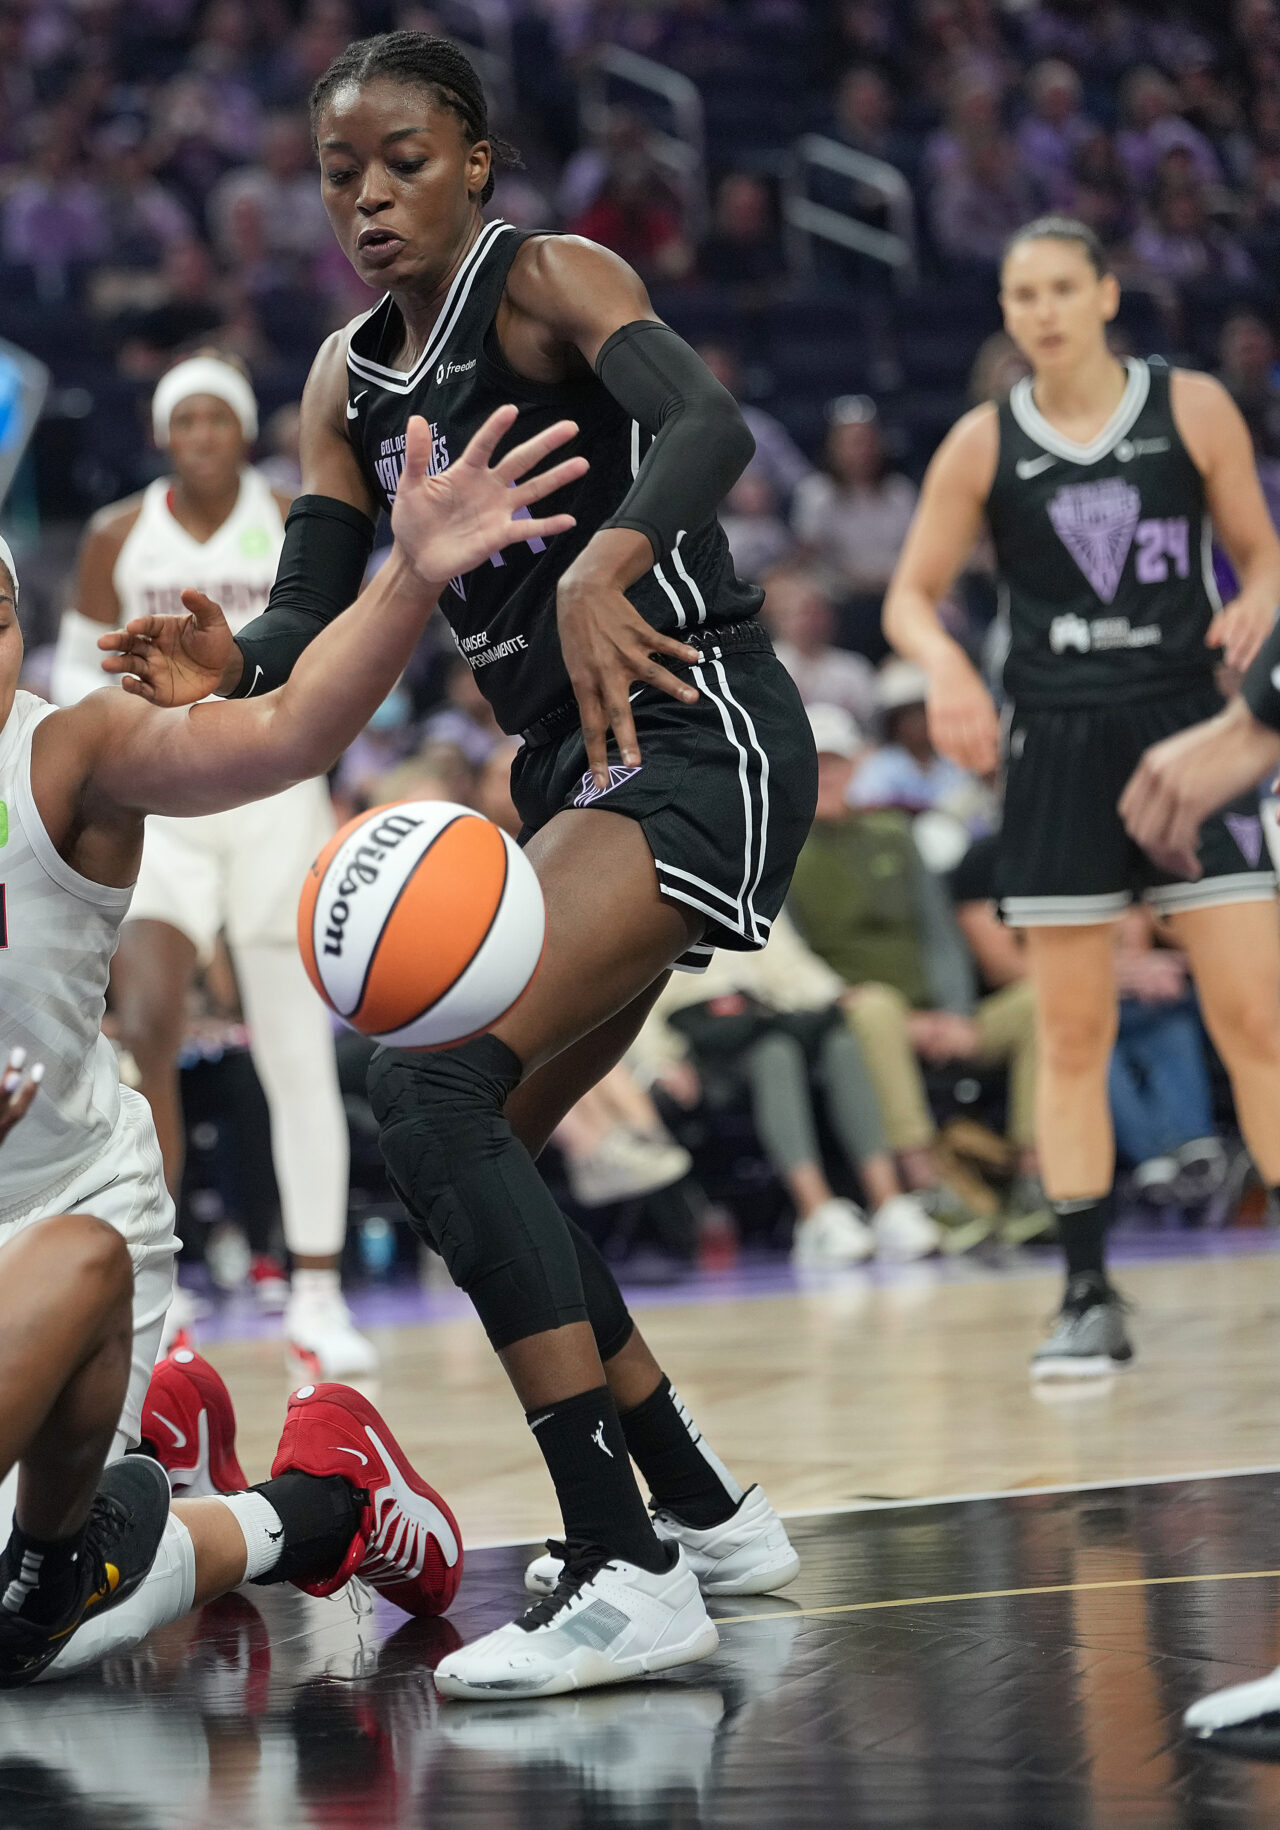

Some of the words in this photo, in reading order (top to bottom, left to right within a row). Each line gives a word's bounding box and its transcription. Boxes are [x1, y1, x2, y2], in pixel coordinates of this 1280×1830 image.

[446, 359, 477, 379] freedom
[380, 433, 408, 456] GOLDE
[1135, 516, 1190, 584] 24
[461, 631, 491, 653] KAISER
[323, 814, 426, 958] Wilson
